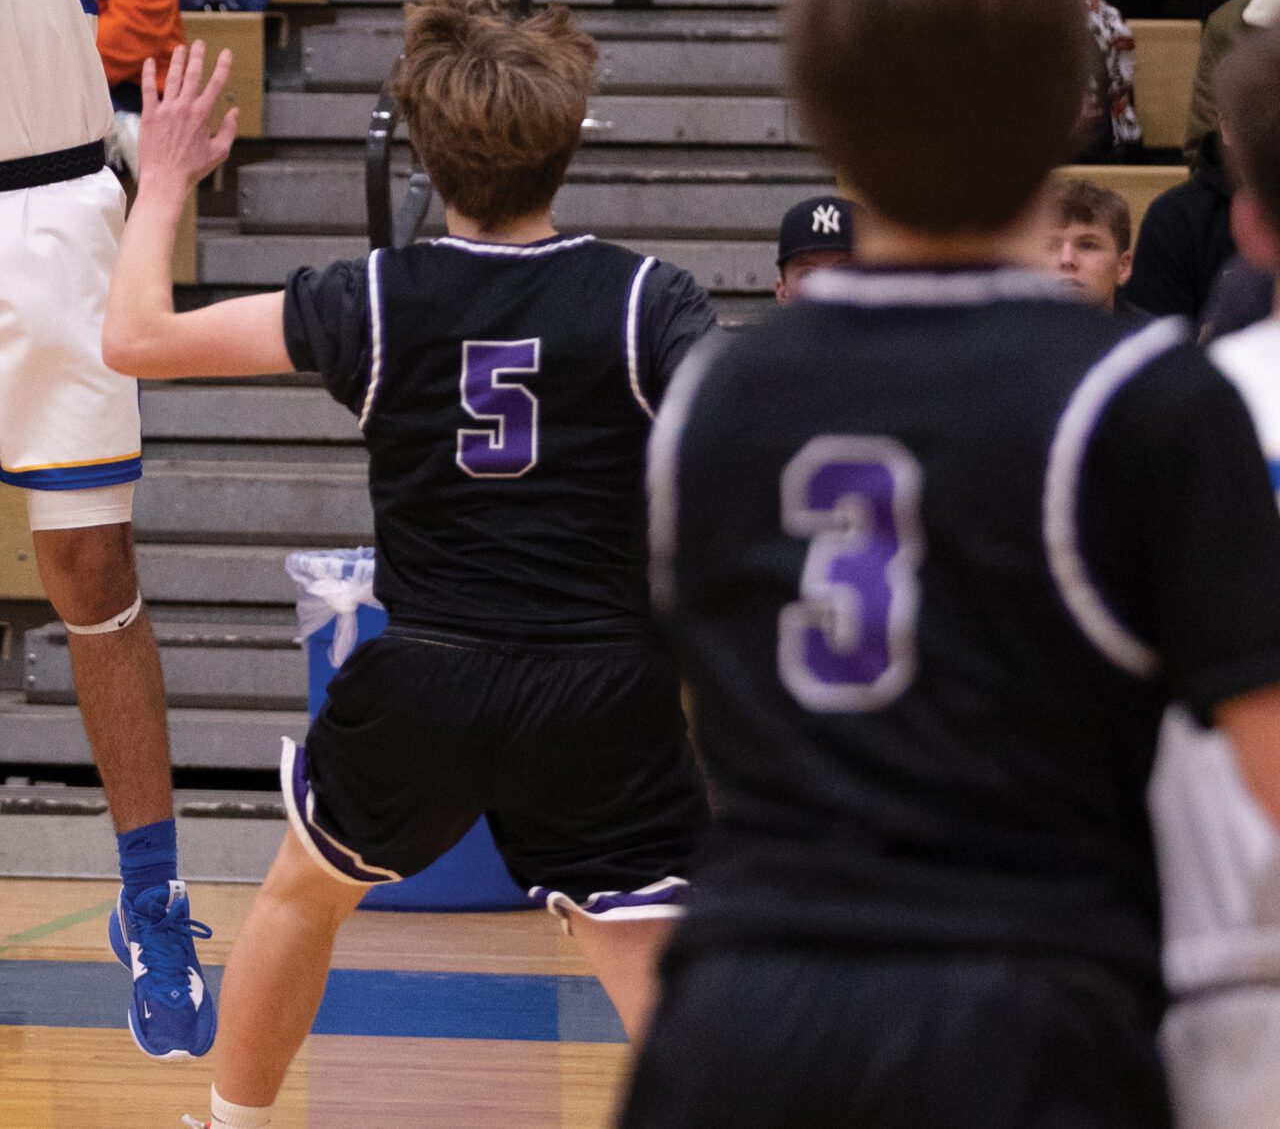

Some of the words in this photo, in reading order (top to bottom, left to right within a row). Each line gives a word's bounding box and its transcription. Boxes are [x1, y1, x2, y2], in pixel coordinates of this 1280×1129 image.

[812, 204, 841, 234] NY
[456, 337, 541, 478] 5
[777, 433, 925, 714] 3
